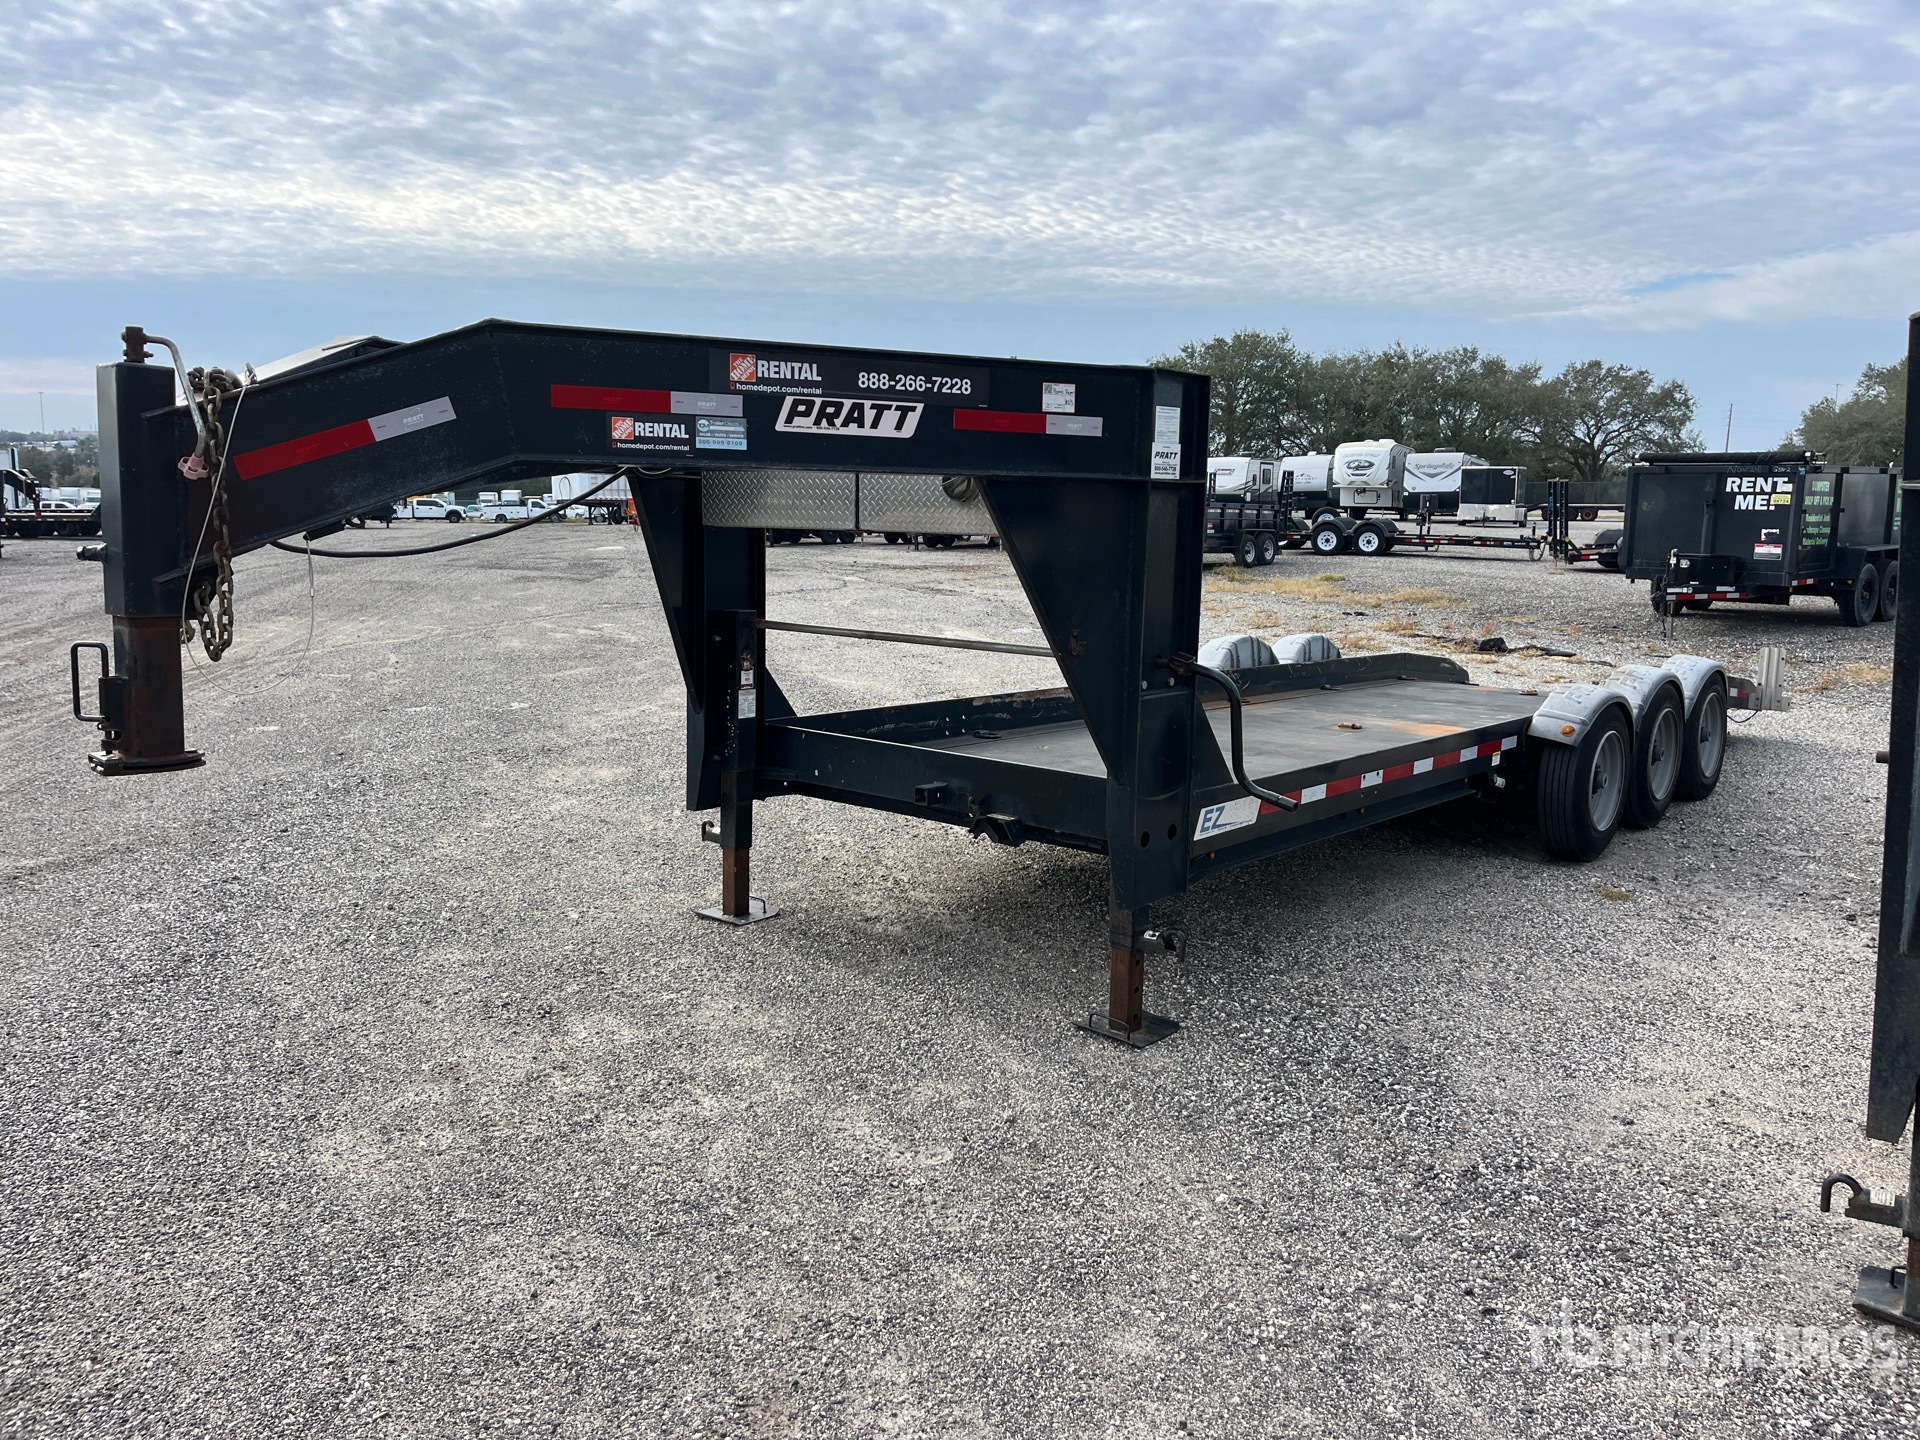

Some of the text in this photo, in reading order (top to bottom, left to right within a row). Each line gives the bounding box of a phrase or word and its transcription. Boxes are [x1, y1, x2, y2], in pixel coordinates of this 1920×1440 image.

[730, 355, 756, 380] HOME
[757, 360, 822, 381] RENTAL
[736, 383, 822, 394] homedepot.com/rental
[858, 372, 971, 394] 888-266-7228
[784, 398, 918, 431] PRATT
[612, 418, 634, 439] HOME
[634, 422, 689, 438] RENTAL
[617, 442, 689, 451] homedepot.com/rental
[1154, 451, 1178, 460] PRATT
[1725, 477, 1788, 493] RENT
[1200, 805, 1226, 833] EZ
